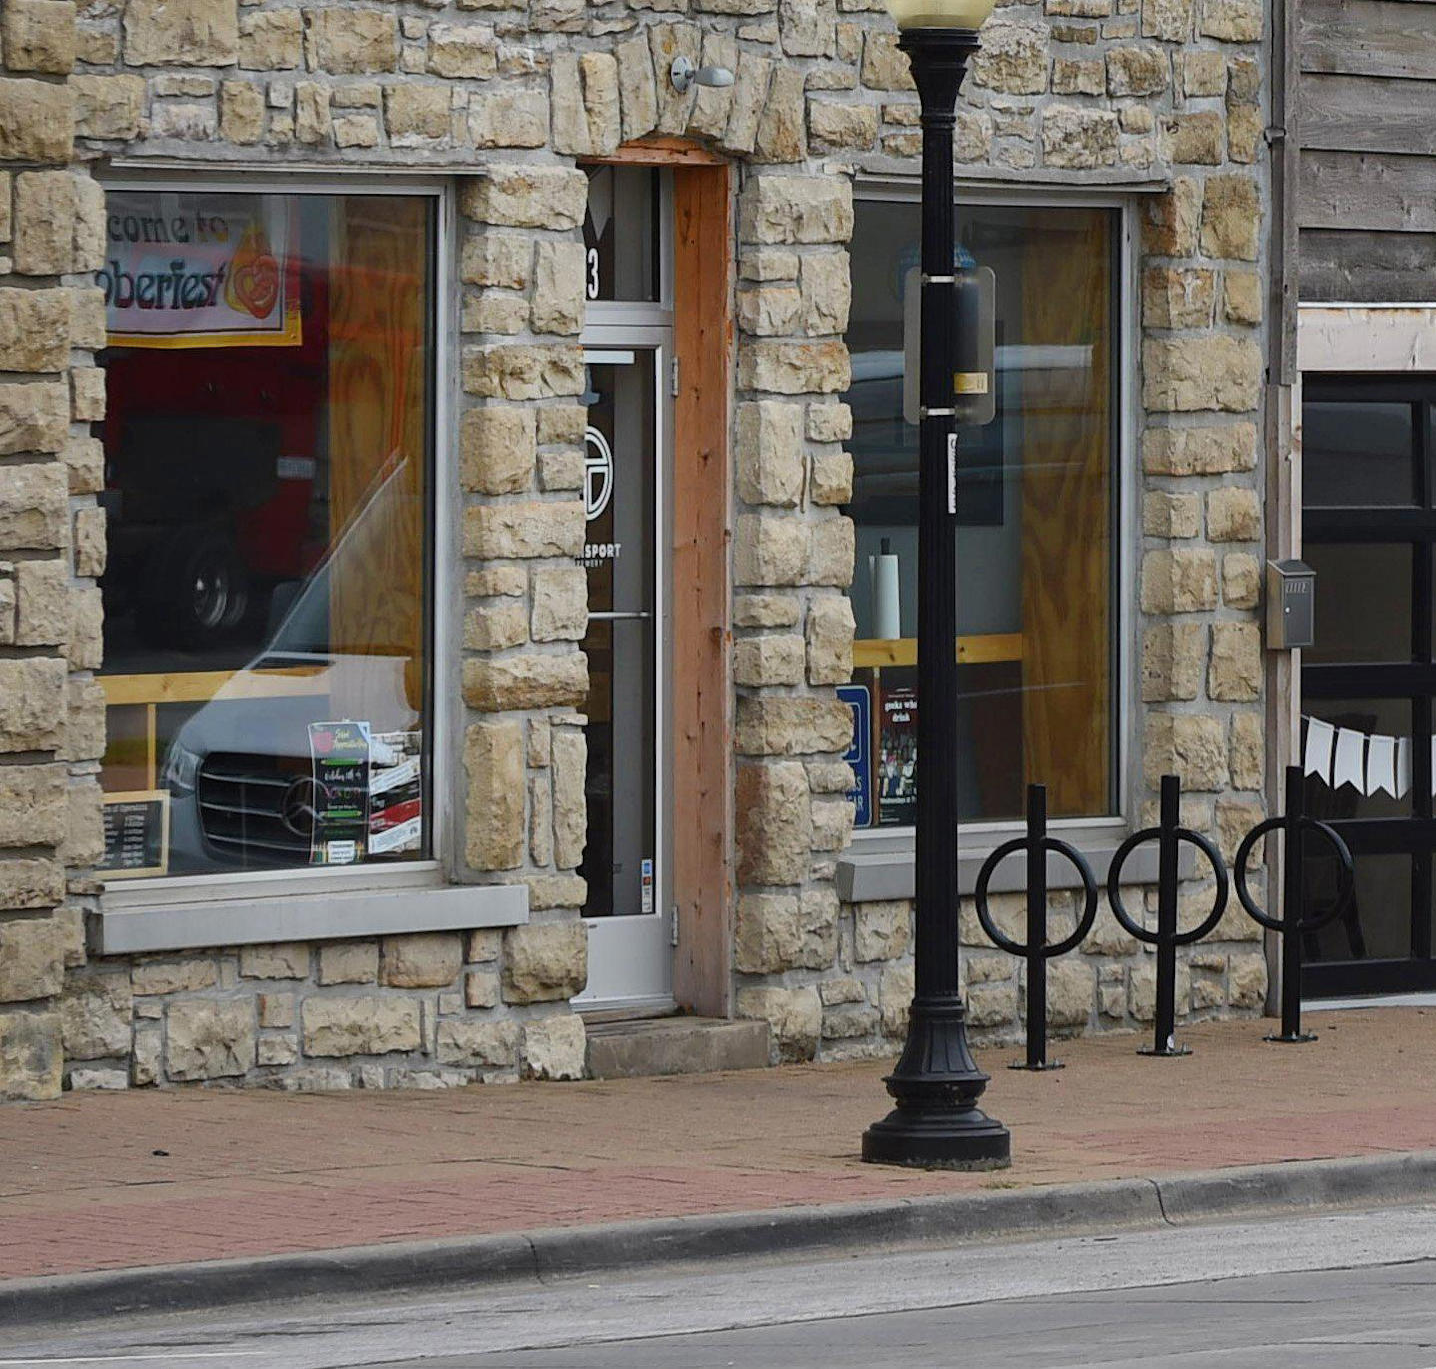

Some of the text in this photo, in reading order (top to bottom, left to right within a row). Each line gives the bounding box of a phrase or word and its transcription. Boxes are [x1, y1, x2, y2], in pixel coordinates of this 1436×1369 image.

[106, 212, 229, 244] come to
[94, 259, 228, 310] oberfest
[584, 543, 621, 559] SPORT
